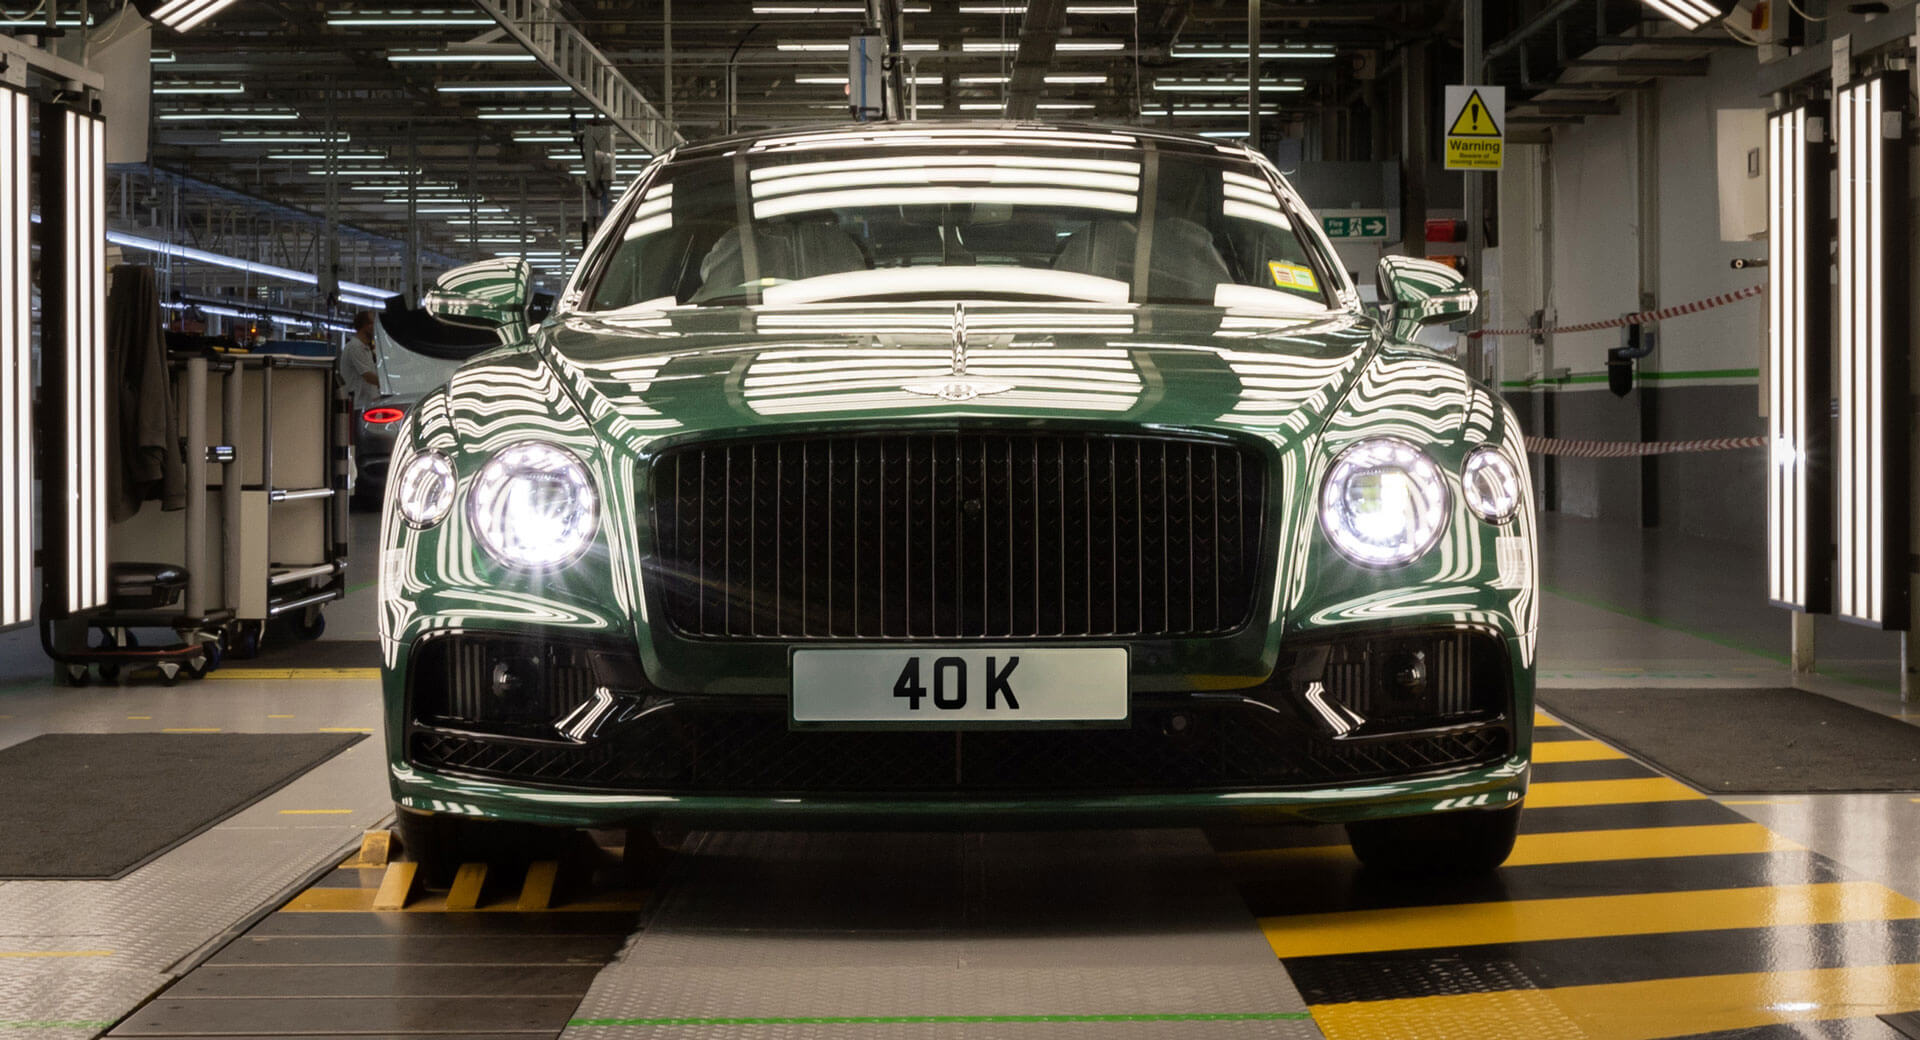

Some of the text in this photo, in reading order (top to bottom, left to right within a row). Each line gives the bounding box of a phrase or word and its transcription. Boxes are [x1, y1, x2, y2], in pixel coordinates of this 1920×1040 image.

[1449, 140, 1500, 154] Warning
[893, 656, 1020, 710] 40 K
